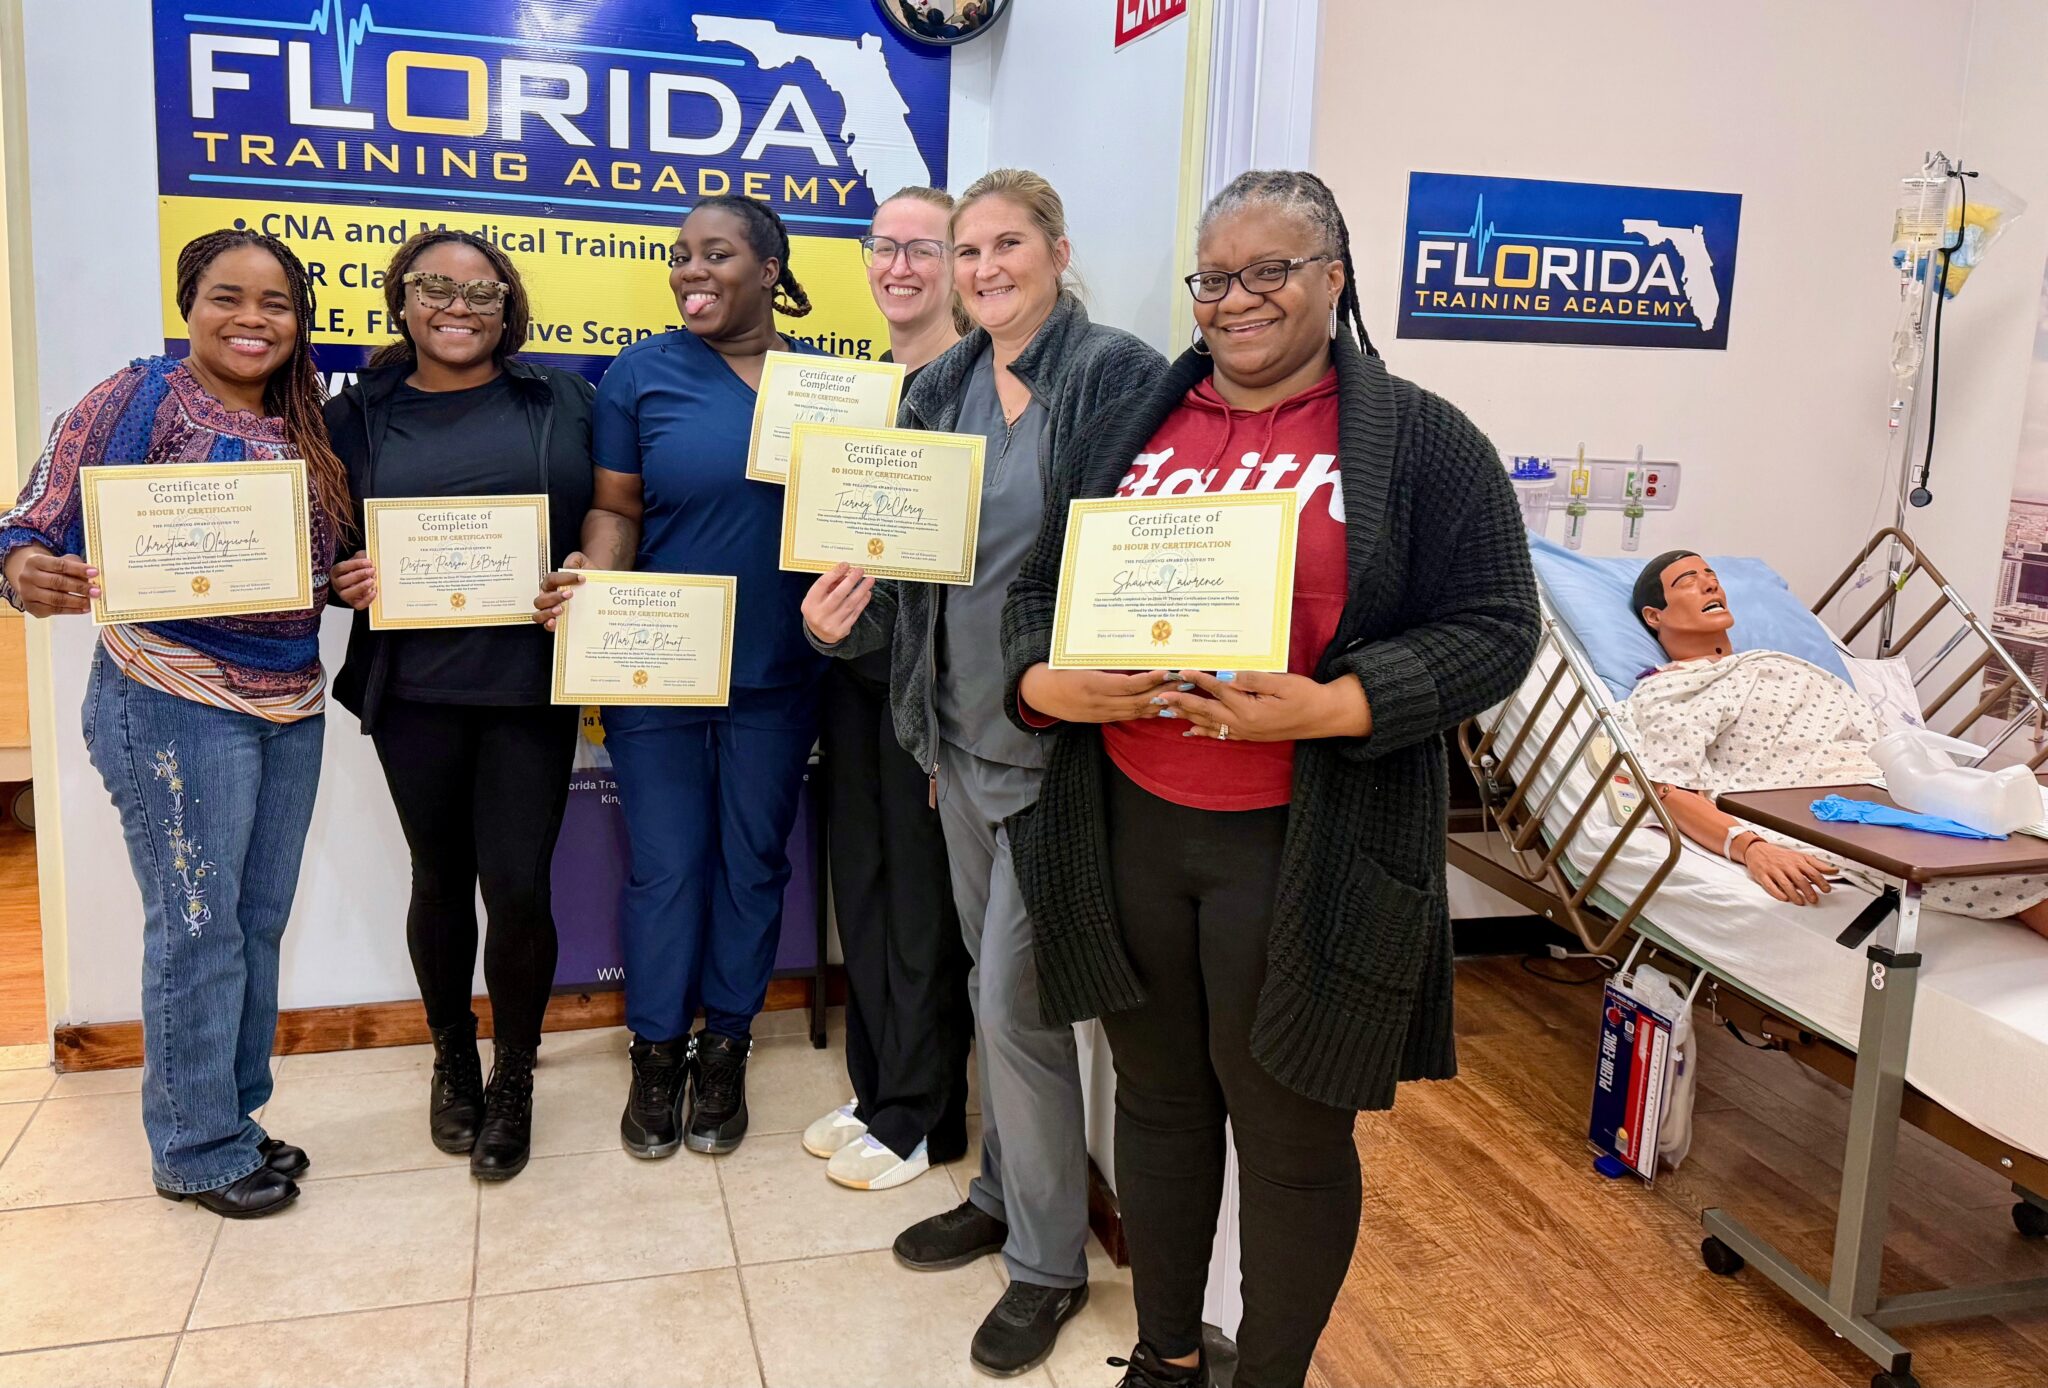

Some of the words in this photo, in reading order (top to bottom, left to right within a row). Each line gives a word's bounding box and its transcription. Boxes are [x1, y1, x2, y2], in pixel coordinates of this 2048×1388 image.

[190, 33, 839, 166] FLORIDA
[193, 132, 527, 182] TRAINING
[564, 158, 858, 206] ACADEMY
[261, 213, 334, 241] CNA
[345, 219, 407, 244] and
[1416, 240, 1680, 296] FLORIDA
[1415, 290, 1550, 311] TRAINING
[1563, 296, 1688, 317] ACADEMY
[800, 369, 844, 383] Certificate
[846, 374, 857, 384] of
[800, 378, 850, 393] Completion
[844, 442, 907, 457] Certificate
[910, 448, 925, 459] of
[848, 453, 918, 469] Completion
[842, 468, 864, 476] HOUR
[874, 471, 932, 482] CERTIFICATION
[148, 481, 220, 493] Certificate
[224, 479, 239, 490] of
[153, 491, 235, 505] Completion
[149, 508, 175, 516] HOUR
[187, 505, 252, 515] CERTIFICATION
[417, 511, 477, 522] Certificate
[480, 511, 492, 520] of
[1128, 513, 1201, 526] Certificate
[1205, 511, 1223, 522] of
[422, 521, 489, 532] Completion
[1131, 523, 1214, 539] Completion
[449, 533, 503, 541] CERTIFICATION
[1124, 543, 1149, 551] HOUR
[1151, 542, 1161, 550] IV
[1162, 540, 1232, 550] CERTIFICATION
[1167, 569, 1224, 593] Lawrence
[609, 587, 666, 597] Certificate
[670, 589, 682, 598] of
[612, 596, 677, 608] Completion
[568, 780, 597, 790] orida
[599, 780, 618, 789] Tra
[601, 794, 621, 805] Kin
